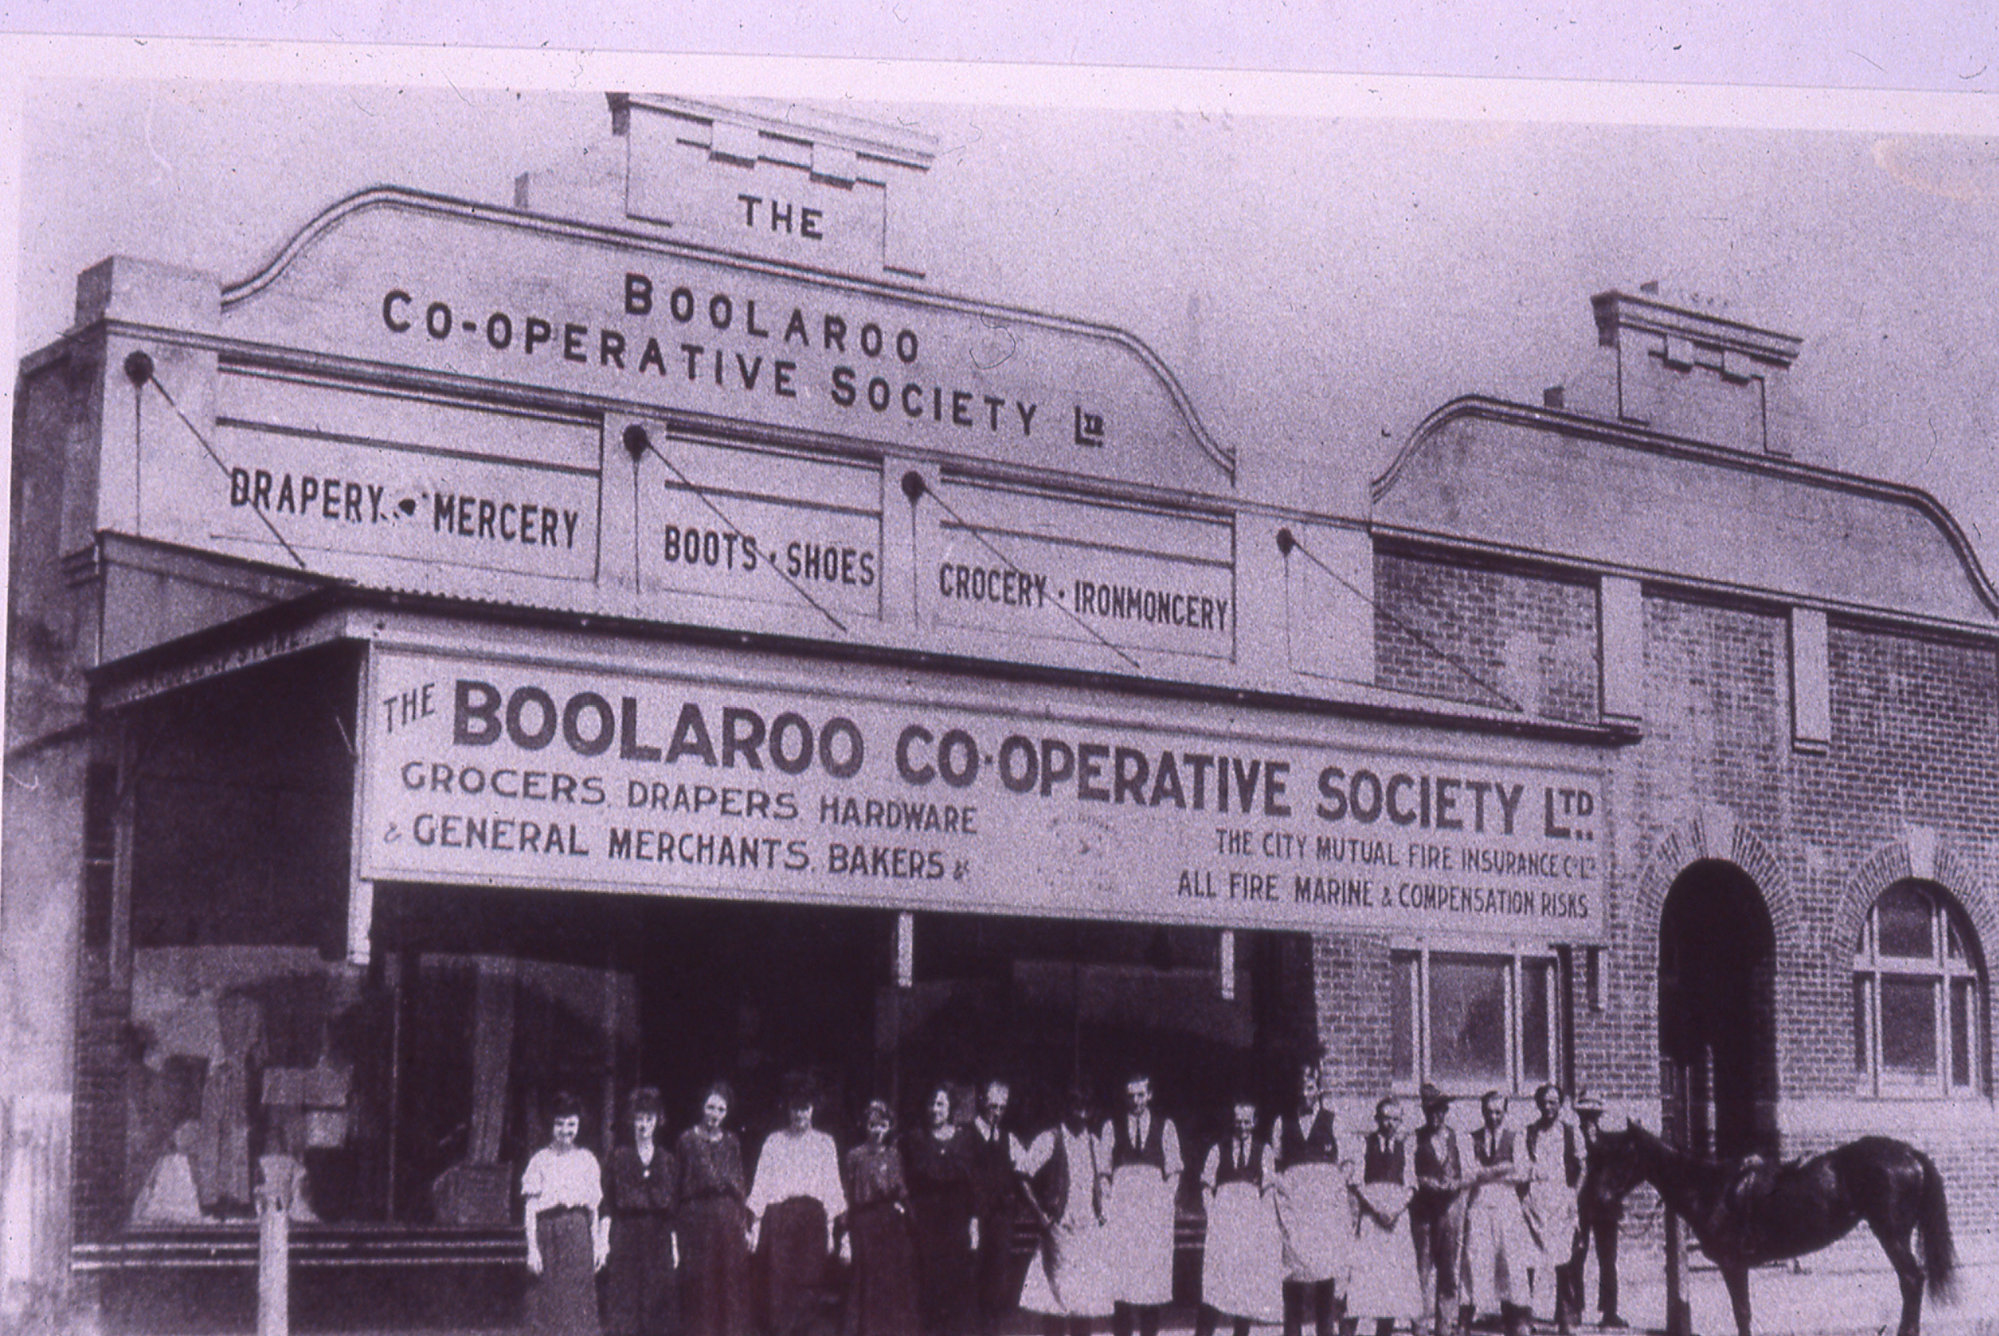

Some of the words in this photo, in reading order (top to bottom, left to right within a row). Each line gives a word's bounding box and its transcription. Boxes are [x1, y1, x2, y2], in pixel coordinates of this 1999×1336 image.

[737, 193, 823, 241] THE
[625, 272, 918, 361] BOOLAROO
[382, 289, 798, 399] CO-OPERATIVE
[830, 367, 1037, 437] SOCIETY
[230, 467, 384, 524] DRAPERY
[433, 492, 579, 549] MERCERY
[664, 524, 758, 572] BOOTS
[787, 541, 875, 587] SHOES
[382, 682, 436, 734] THE
[452, 679, 865, 778] BOOLAROO
[1317, 766, 1525, 835] SOCIETY
[628, 780, 799, 821] DRAPERS
[820, 796, 977, 835] HARDWARE
[413, 813, 590, 857] GENERAL
[828, 843, 945, 880] BAKERS
[1215, 828, 1253, 856] THE
[1261, 831, 1307, 859] CITY
[1315, 835, 1400, 867] MUTUAL
[1408, 843, 1453, 871] FIRE
[1461, 848, 1560, 879] INSURANCE
[1177, 869, 1217, 899] ALL
[1229, 872, 1279, 902] FIRE
[1294, 875, 1373, 907] MARINE
[1381, 886, 1393, 908] &
[1398, 882, 1535, 915] COMPENSATION
[1541, 891, 1589, 919] RISKS
